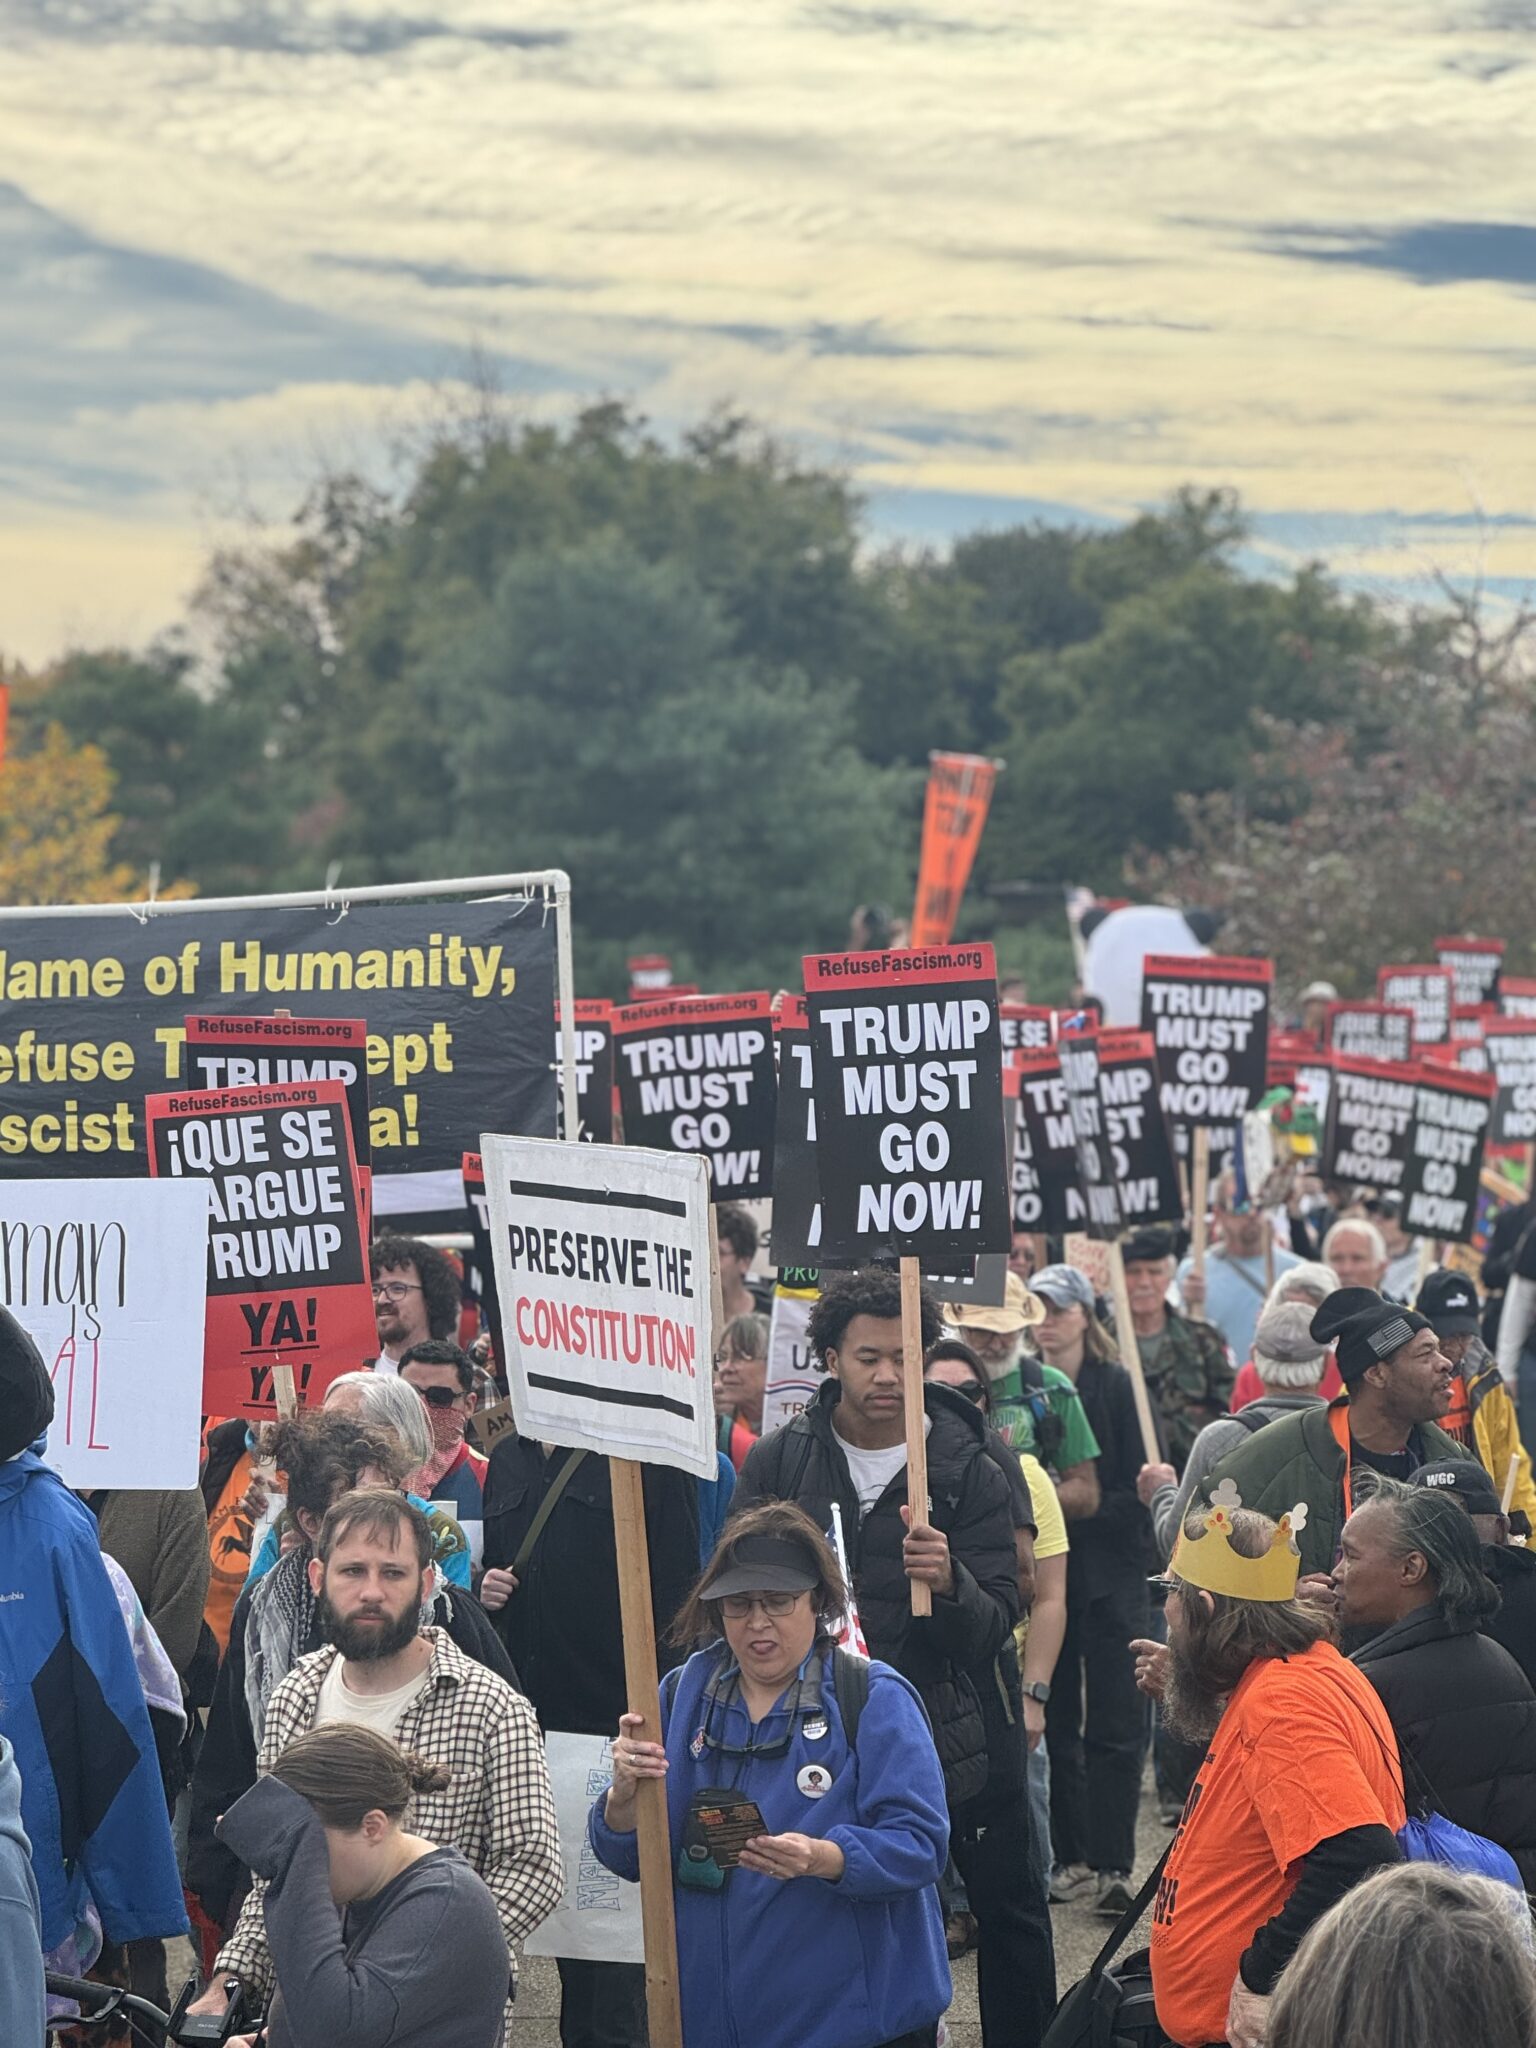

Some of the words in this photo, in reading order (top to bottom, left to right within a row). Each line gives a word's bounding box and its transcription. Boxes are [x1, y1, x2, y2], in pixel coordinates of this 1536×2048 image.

[144, 941, 201, 996] of
[220, 933, 516, 997] Humanity,
[818, 950, 982, 977] RefuseFascism.org
[621, 998, 758, 1022] RefuseFascism.org
[1147, 982, 1266, 1018] TRUMP
[198, 1019, 353, 1039] RefuseFascism.org
[820, 999, 990, 1058] TRUMP
[1020, 1019, 1048, 1047] SE
[1156, 1016, 1253, 1051] MUST
[196, 1056, 358, 1091] TRUMP
[366, 1023, 453, 1085] ept
[622, 1030, 765, 1077] TRUMP
[1176, 1050, 1229, 1084] GO
[168, 1089, 317, 1113] RefuseFascism.org
[639, 1071, 754, 1115] MUST
[842, 1060, 978, 1116] MUST
[1024, 1067, 1152, 1114] TRMP
[1159, 1082, 1249, 1119] NOW!
[1335, 1073, 1416, 1109] TRUM
[671, 1112, 731, 1149] GO
[1044, 1105, 1145, 1149] MST
[1338, 1101, 1411, 1136] MUST
[1415, 1087, 1489, 1134] TRUMP
[167, 1115, 270, 1176] ¡QUE
[280, 1109, 337, 1160] SE
[879, 1120, 950, 1174] GO
[1351, 1129, 1392, 1156] GO
[1414, 1122, 1477, 1166] MUST
[711, 1150, 761, 1187] W!
[1335, 1151, 1404, 1186] NOW!
[1421, 1160, 1457, 1197] GO
[207, 1166, 345, 1223] ARGUE
[856, 1180, 983, 1234] NOW!
[1064, 1177, 1160, 1221] NW!
[207, 1223, 342, 1280] RUMP
[508, 1224, 651, 1288] PRESERVE
[654, 1243, 694, 1299] THE
[240, 1298, 317, 1347] YA!
[516, 1296, 696, 1378] CONSTITUTION!
[1426, 1472, 1455, 1487] WGC
